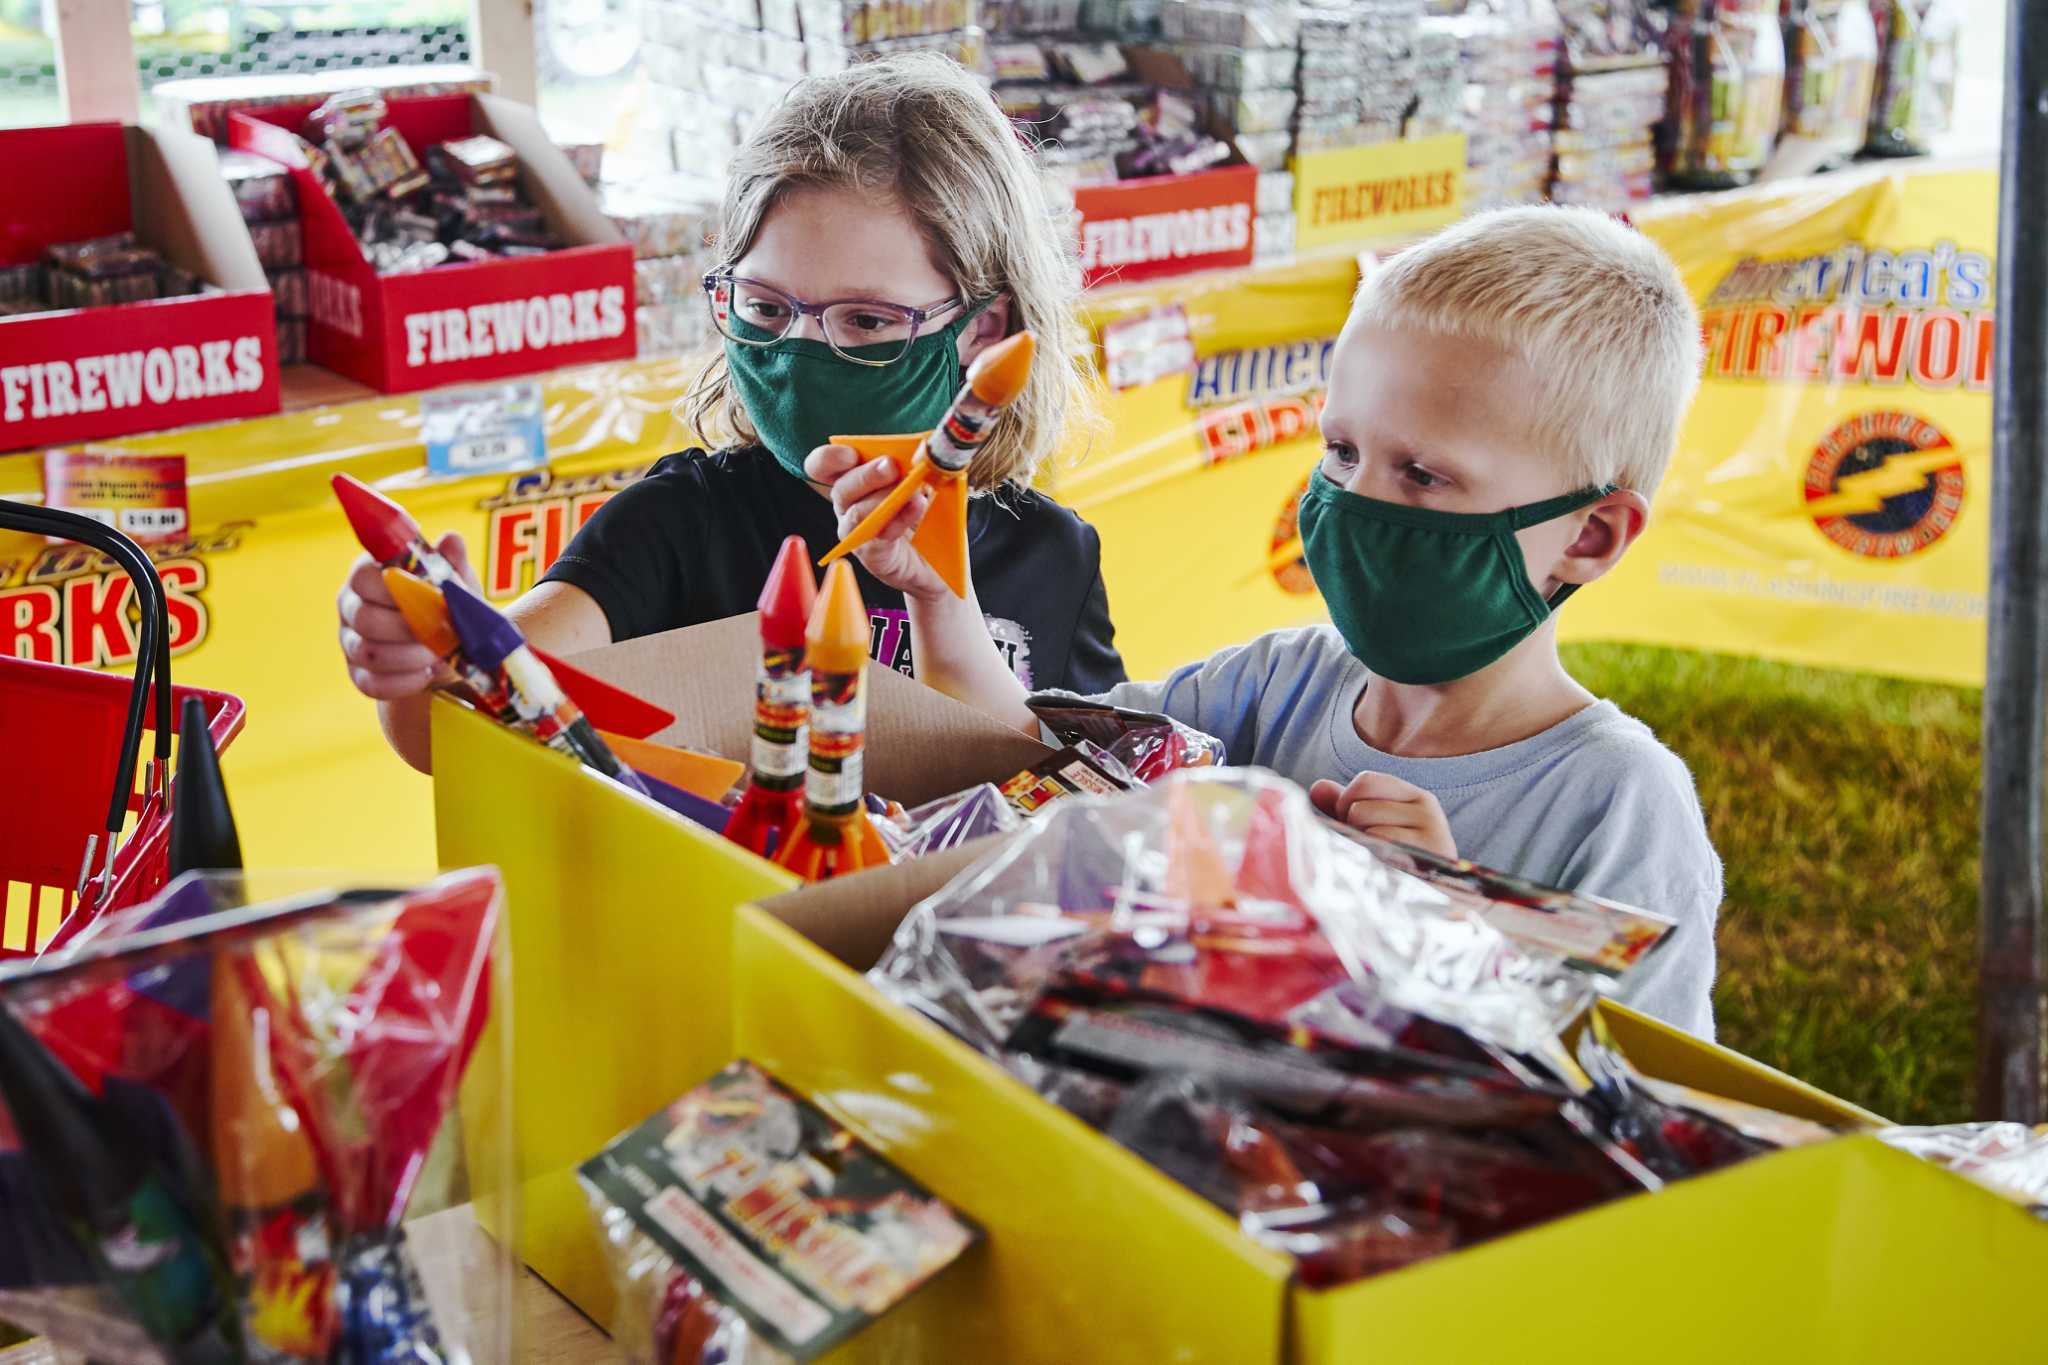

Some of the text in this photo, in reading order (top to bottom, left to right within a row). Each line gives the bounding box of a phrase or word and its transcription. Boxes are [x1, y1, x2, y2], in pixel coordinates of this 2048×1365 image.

[1082, 203, 1250, 268] FIREWORKS
[1312, 171, 1455, 227] FIREWORKS
[405, 286, 626, 368] FIREWORKS
[1, 336, 264, 422] FIREWORKS
